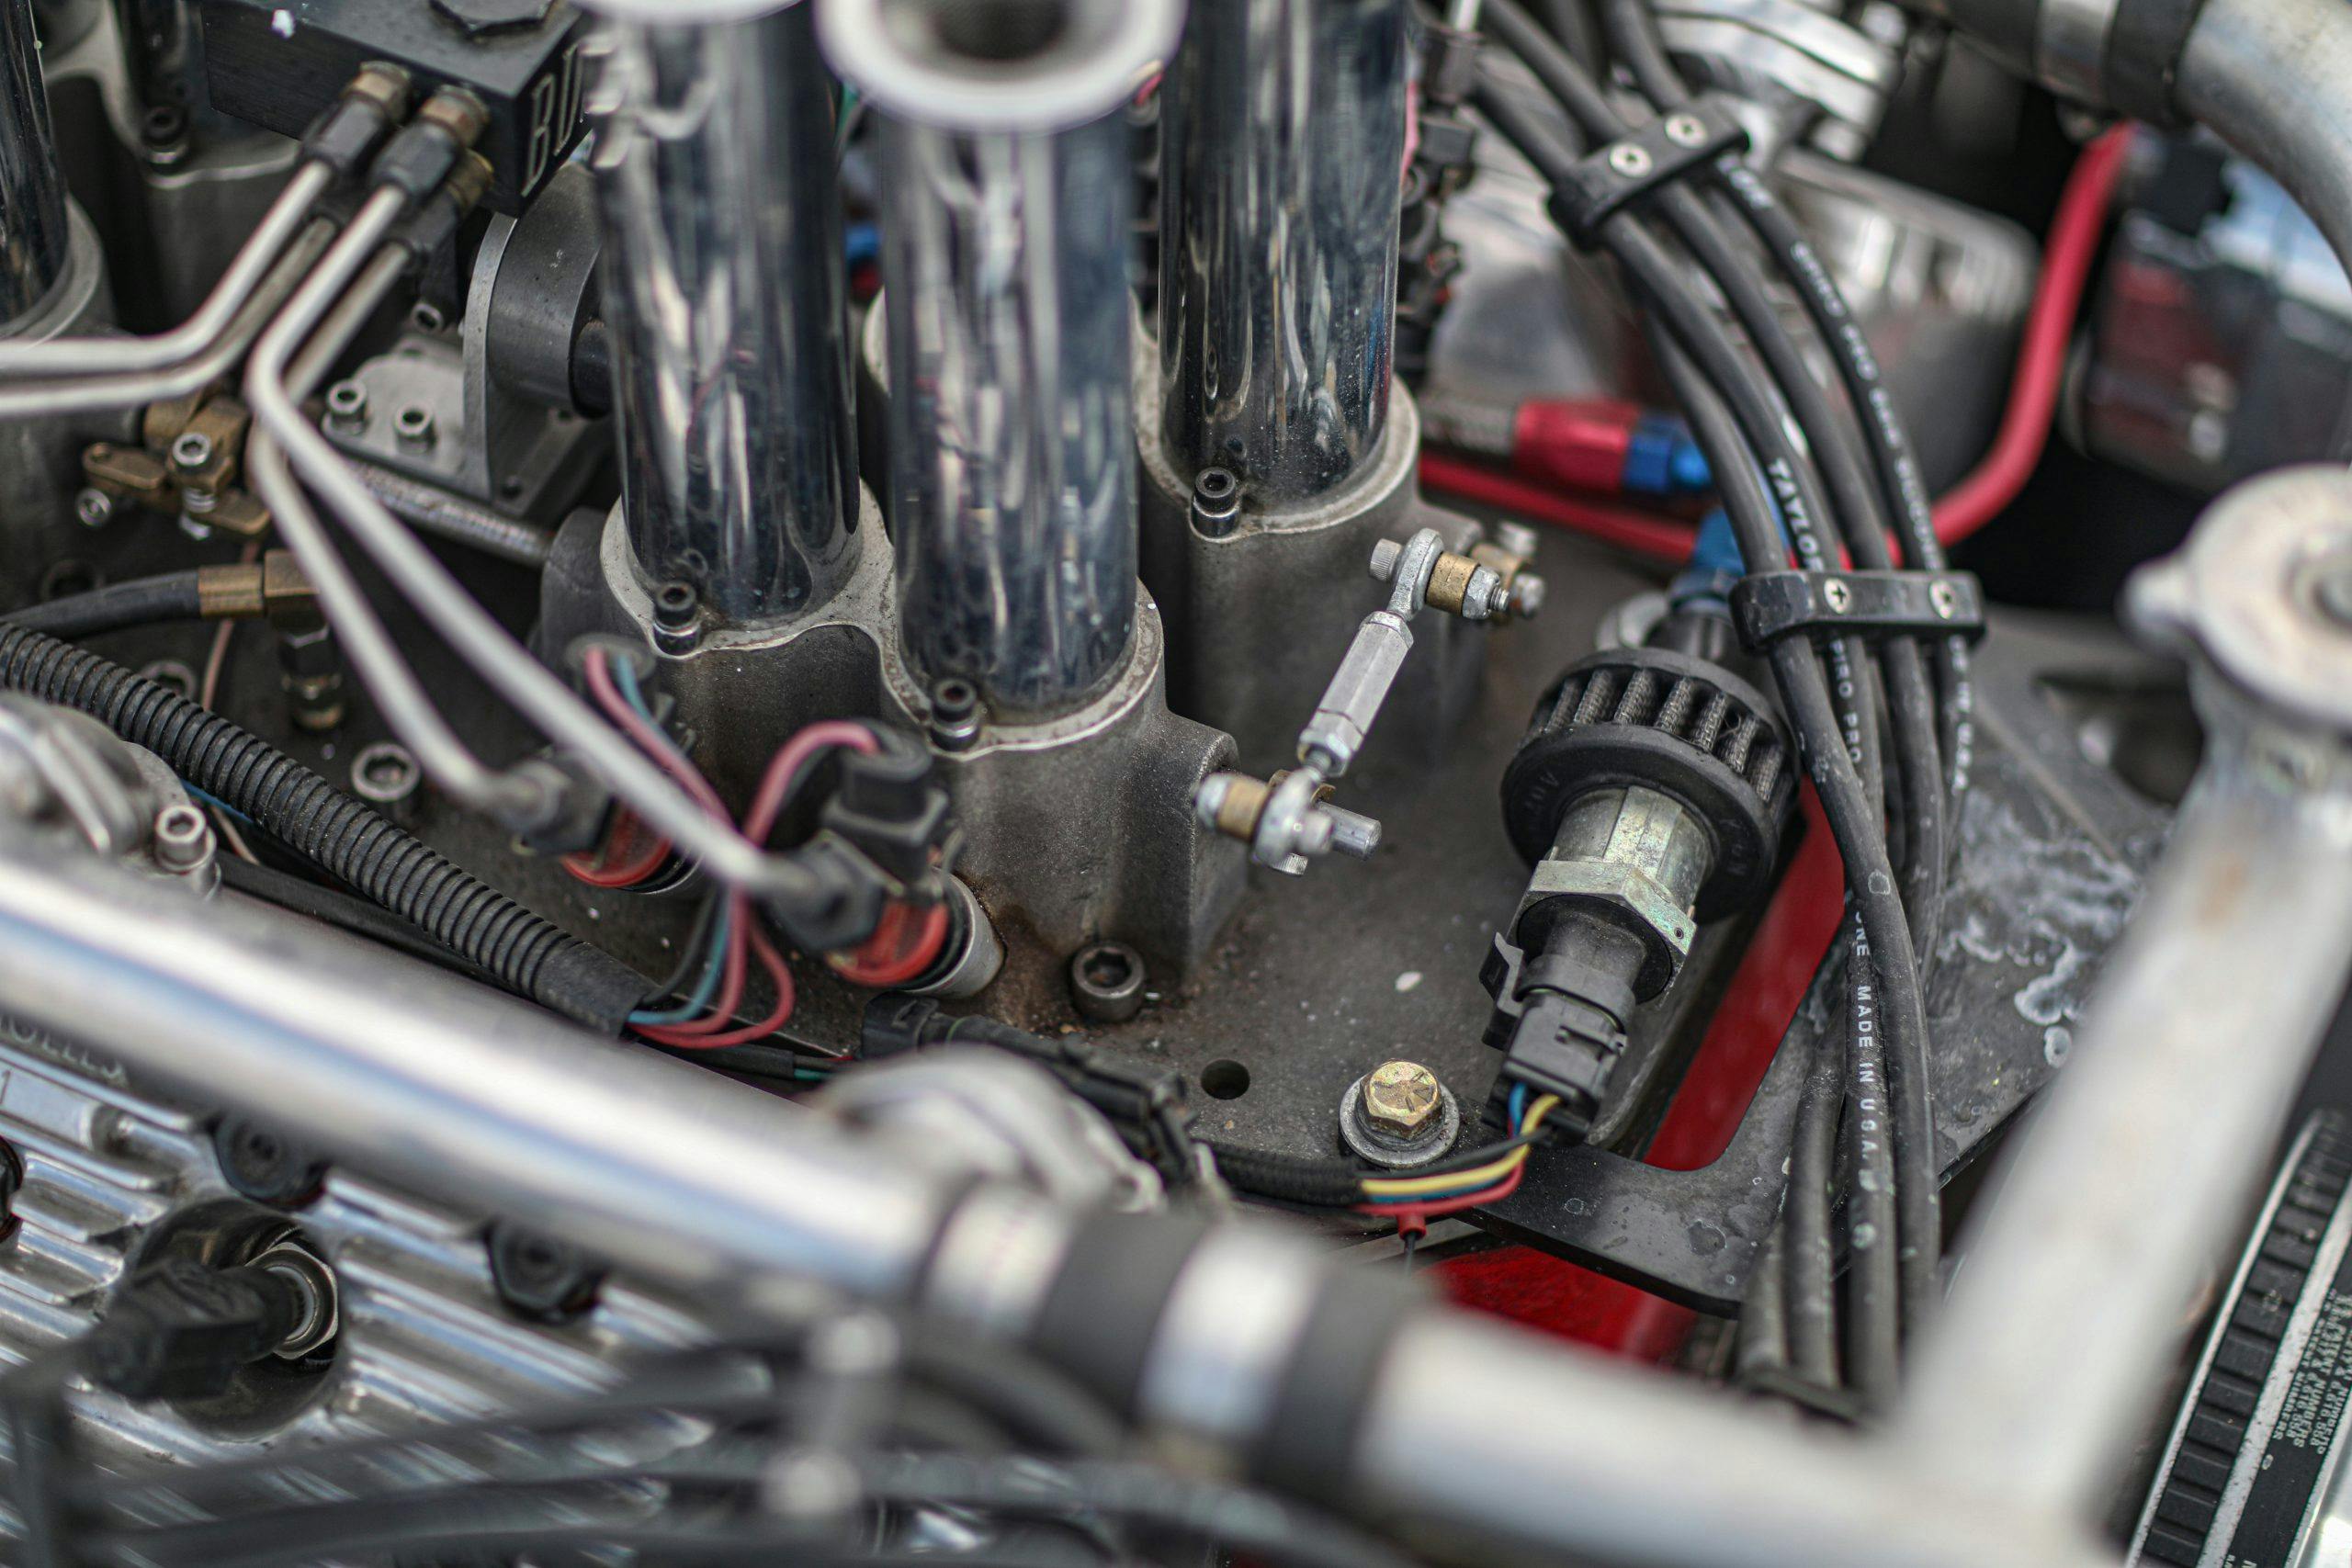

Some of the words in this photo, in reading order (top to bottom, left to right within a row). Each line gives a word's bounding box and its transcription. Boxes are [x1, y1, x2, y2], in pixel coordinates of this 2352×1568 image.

[520, 44, 584, 197] BD
[1829, 637, 1854, 699] PIRO
[1843, 711, 1862, 764] PRO
[1856, 985, 1874, 1049] MADE
[1859, 1062, 1876, 1083] IN
